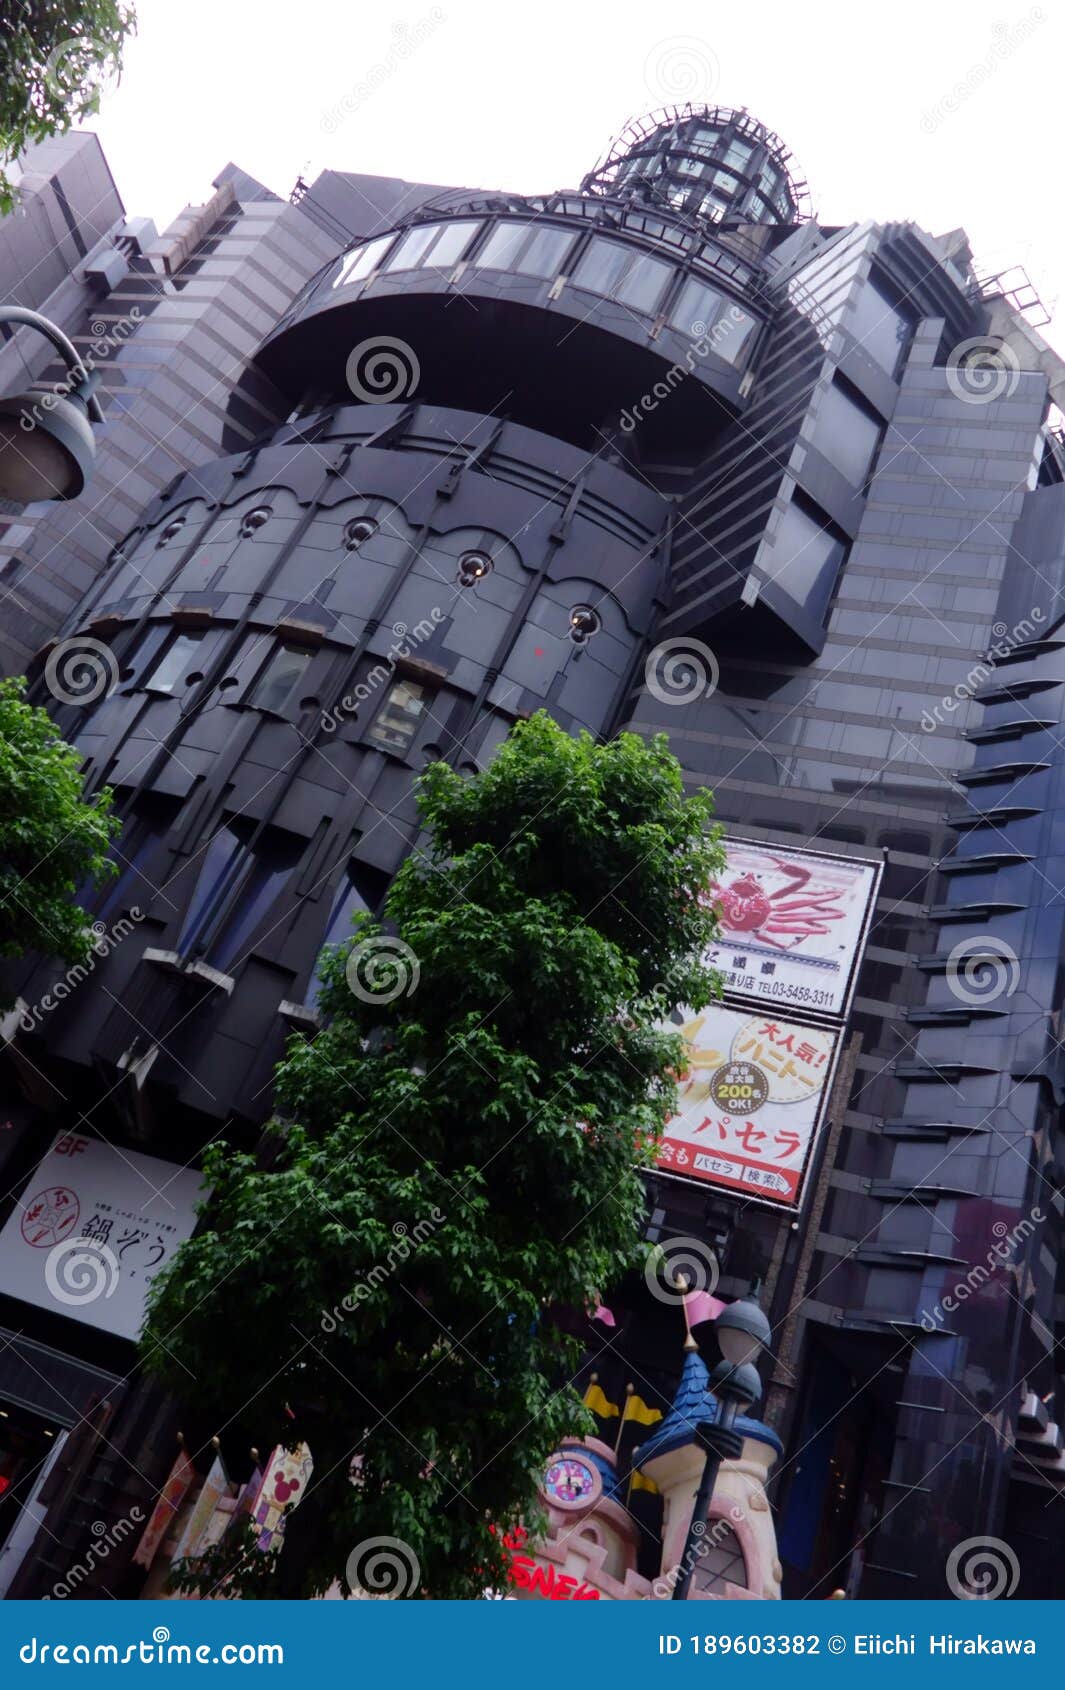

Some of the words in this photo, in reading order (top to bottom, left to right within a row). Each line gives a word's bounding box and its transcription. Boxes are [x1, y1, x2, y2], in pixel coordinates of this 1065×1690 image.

[728, 1098, 752, 1109] OK!
[692, 1116, 801, 1159] パセラ
[77, 1214, 166, 1268] 鍋ぞう
